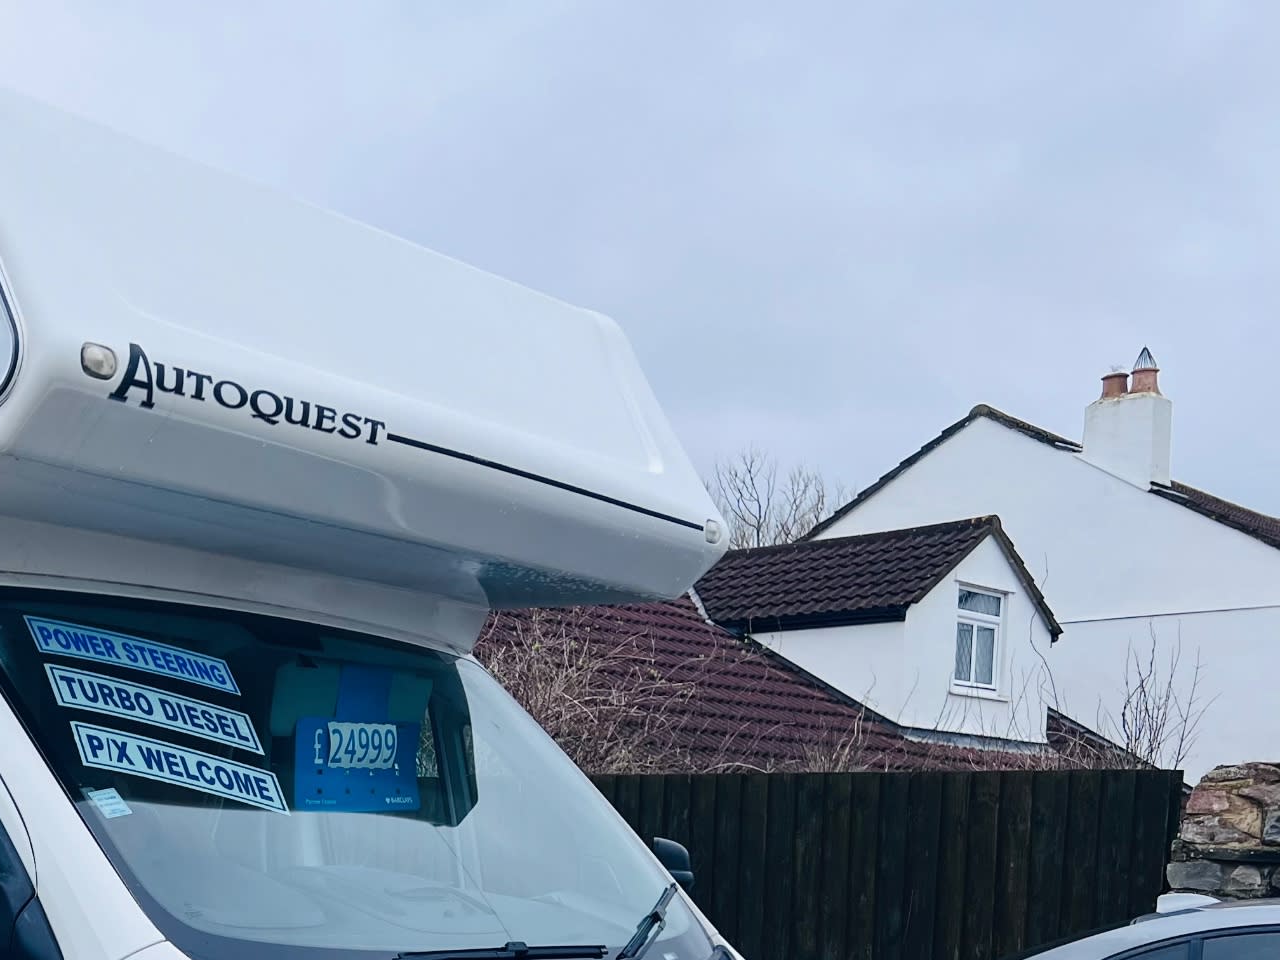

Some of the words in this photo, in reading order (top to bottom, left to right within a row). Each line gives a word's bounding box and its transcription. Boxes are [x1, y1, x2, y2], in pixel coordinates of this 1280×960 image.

[108, 342, 386, 446] AUTOQUEST
[36, 624, 121, 660] POWER
[121, 641, 227, 686] STEERING
[58, 674, 154, 717] TURBO
[158, 697, 251, 743] DIESEL
[136, 744, 275, 803] WELCOME
